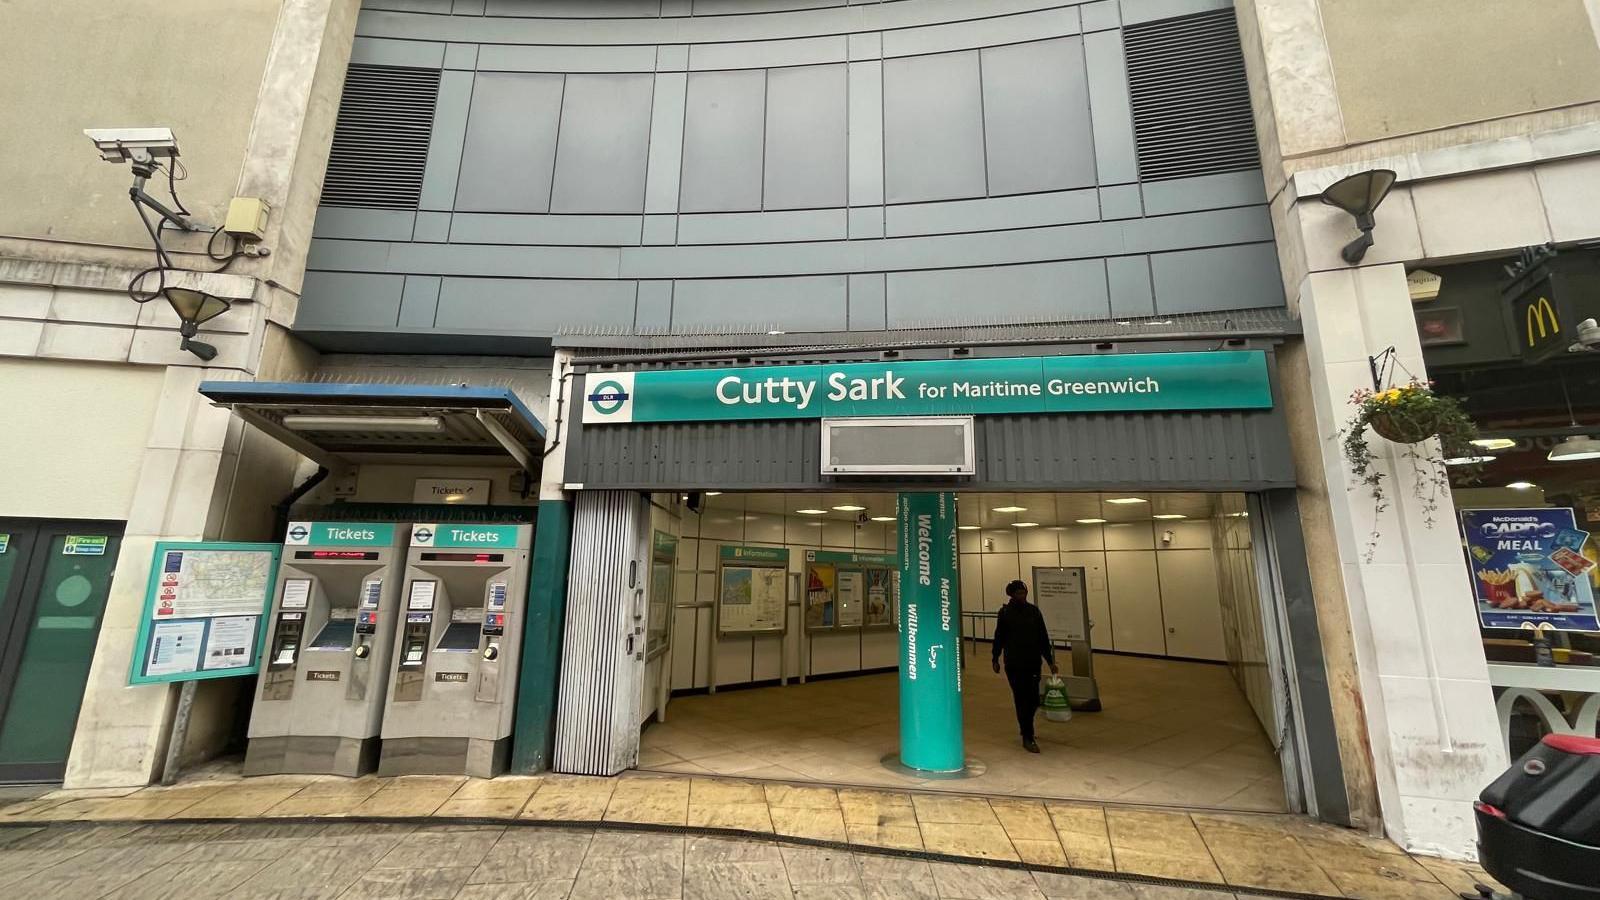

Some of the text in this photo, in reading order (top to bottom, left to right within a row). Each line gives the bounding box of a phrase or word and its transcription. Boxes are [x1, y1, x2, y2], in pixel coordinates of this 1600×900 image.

[715, 370, 1160, 410] Cutty Sark for Maritime Greenwich
[431, 486, 464, 495] Tickets
[327, 528, 375, 540] Tickets
[451, 530, 499, 542] Tickets
[918, 514, 931, 586] Welcome
[1497, 540, 1543, 551] MEAL
[940, 578, 951, 631] Merhaba
[907, 603, 918, 680] Willkommen
[313, 672, 336, 680] Tickets
[441, 673, 463, 681] Tickets
